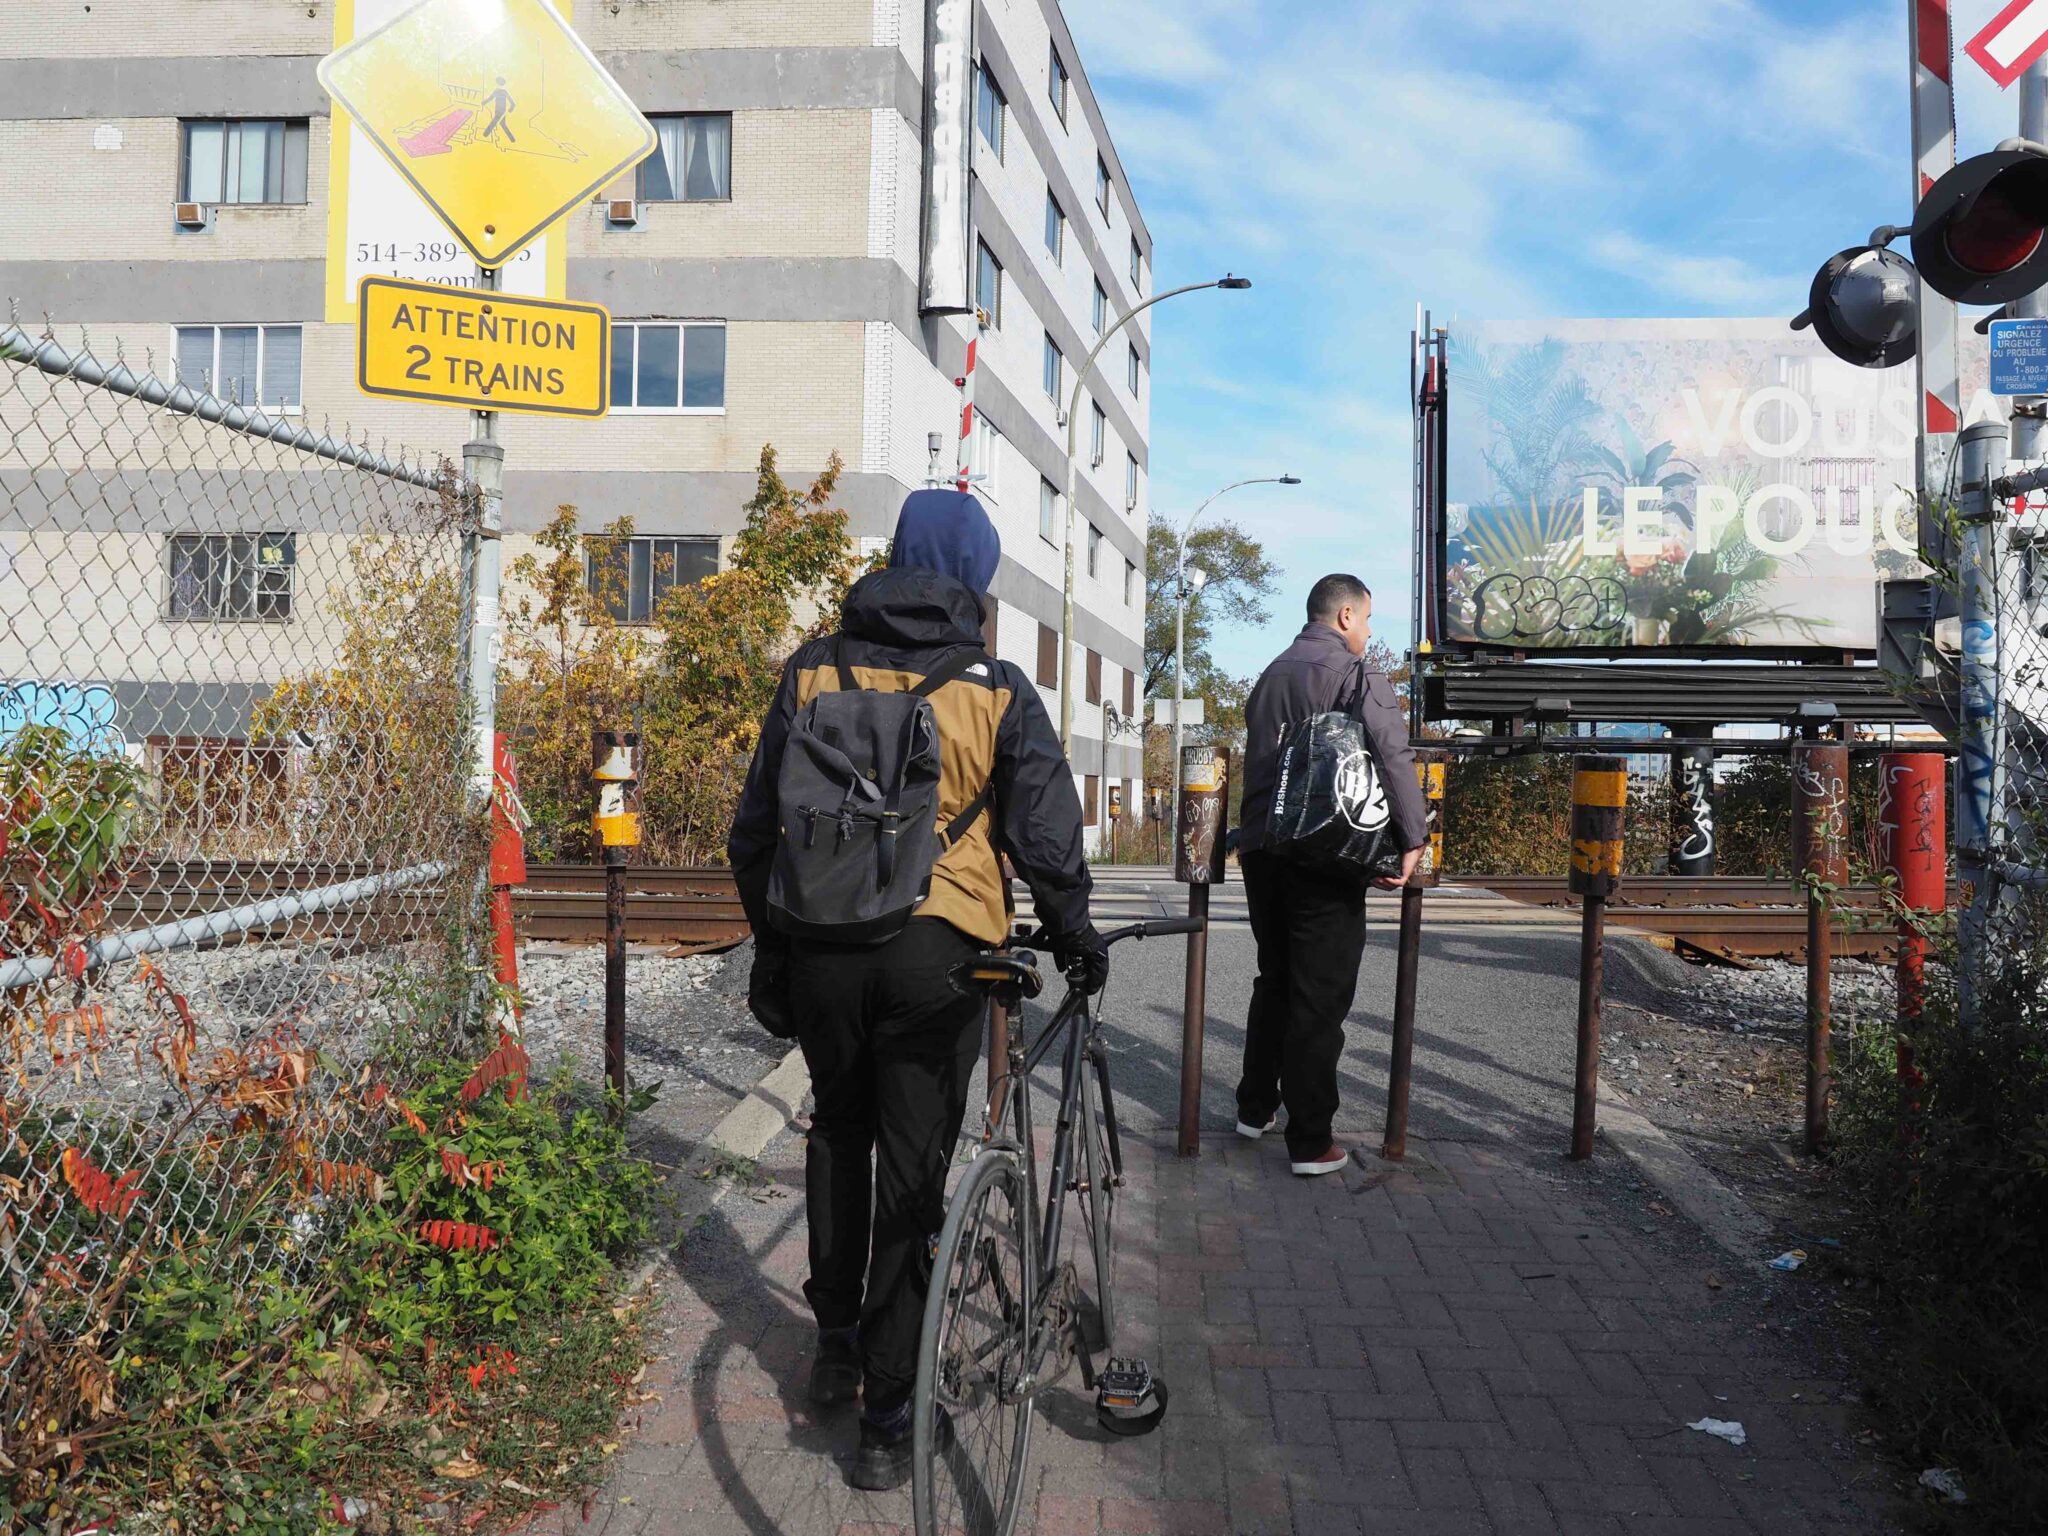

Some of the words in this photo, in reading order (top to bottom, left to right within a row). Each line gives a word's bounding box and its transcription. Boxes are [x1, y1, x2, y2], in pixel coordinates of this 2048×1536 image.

[391, 303, 576, 350] ATTENTION
[1997, 330, 2042, 339] SIGNALEZ
[1997, 339, 2041, 348] URGENCE
[405, 344, 431, 381] 2
[444, 356, 565, 396] TRAINS
[1992, 349, 2004, 358] OU
[2013, 358, 2026, 366] AU
[1682, 386, 1918, 458] VOUS
[1583, 486, 1663, 556] LE
[1274, 746, 1294, 815] B2Shoes.com
